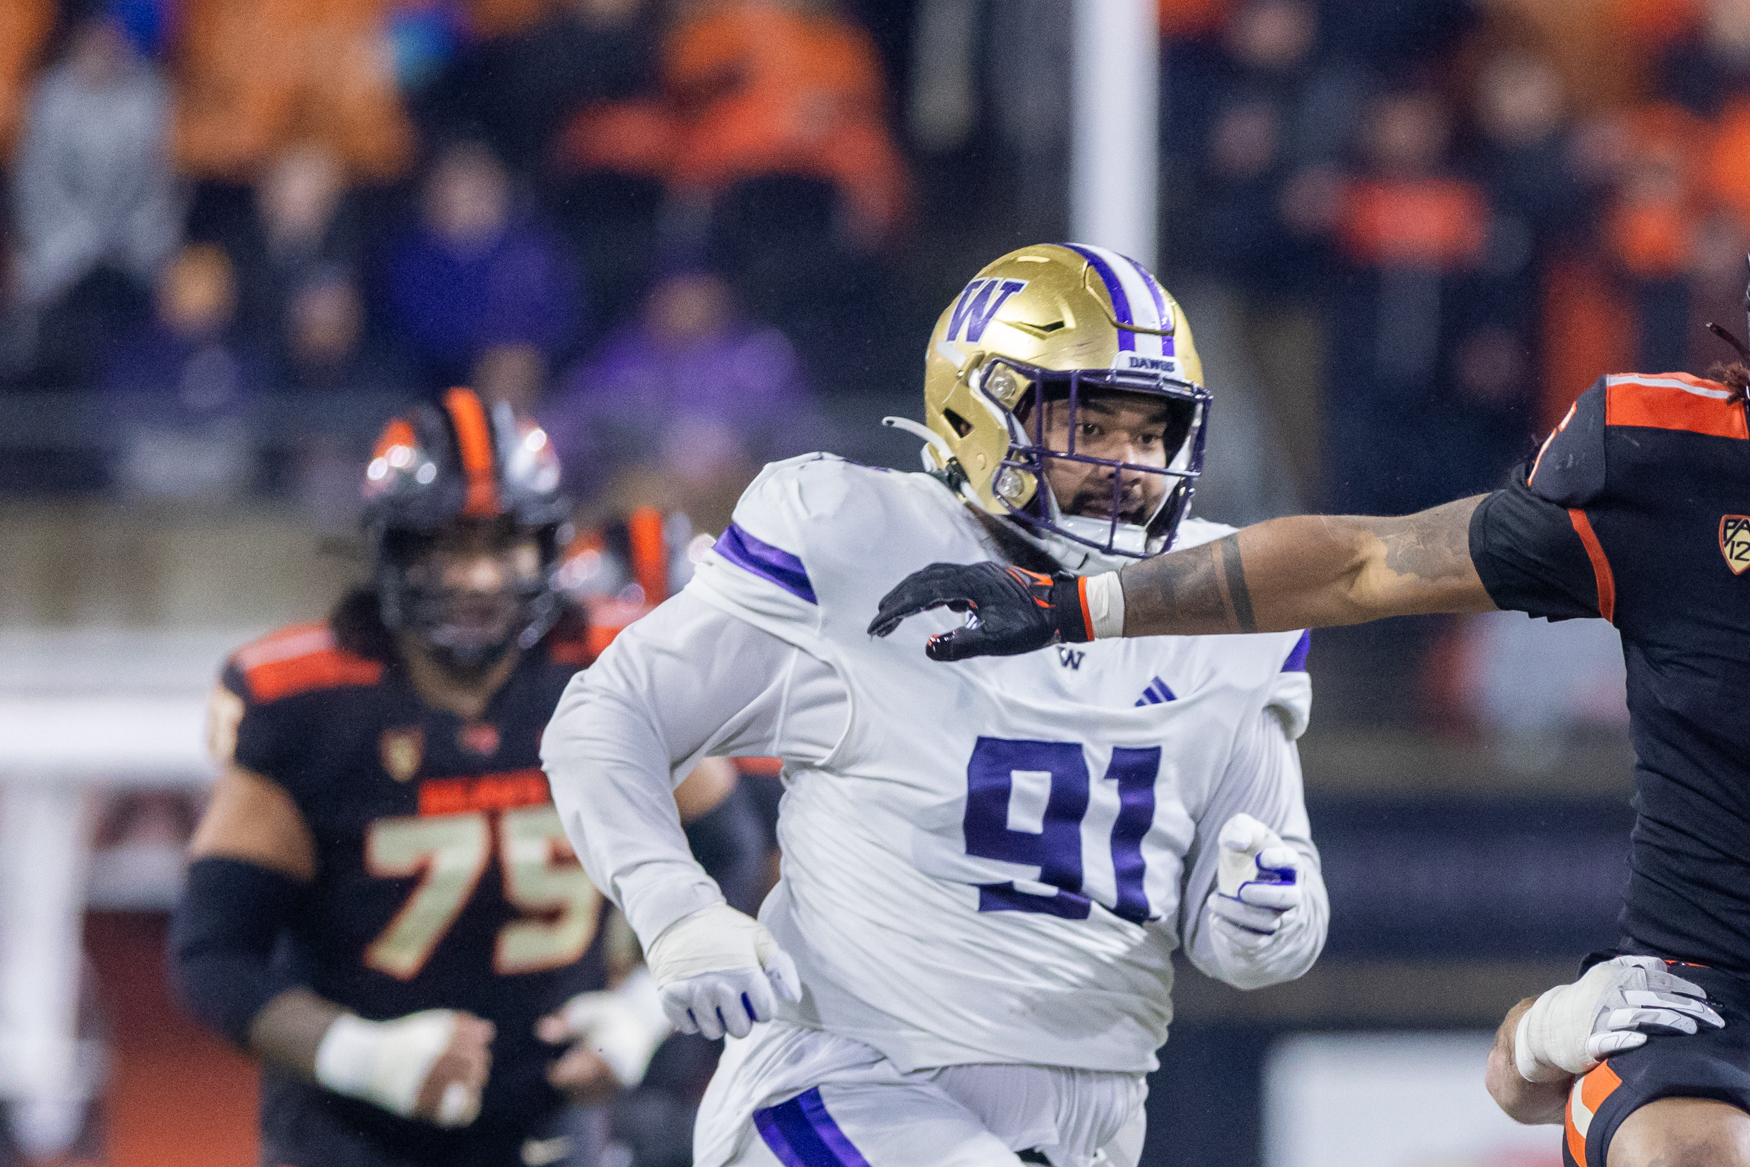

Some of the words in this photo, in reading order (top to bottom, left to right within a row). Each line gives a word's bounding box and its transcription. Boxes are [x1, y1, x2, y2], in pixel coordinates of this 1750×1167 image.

[945, 278, 1029, 345] W
[1056, 645, 1086, 670] W
[963, 735, 1162, 923] 91
[364, 806, 602, 980] 75
